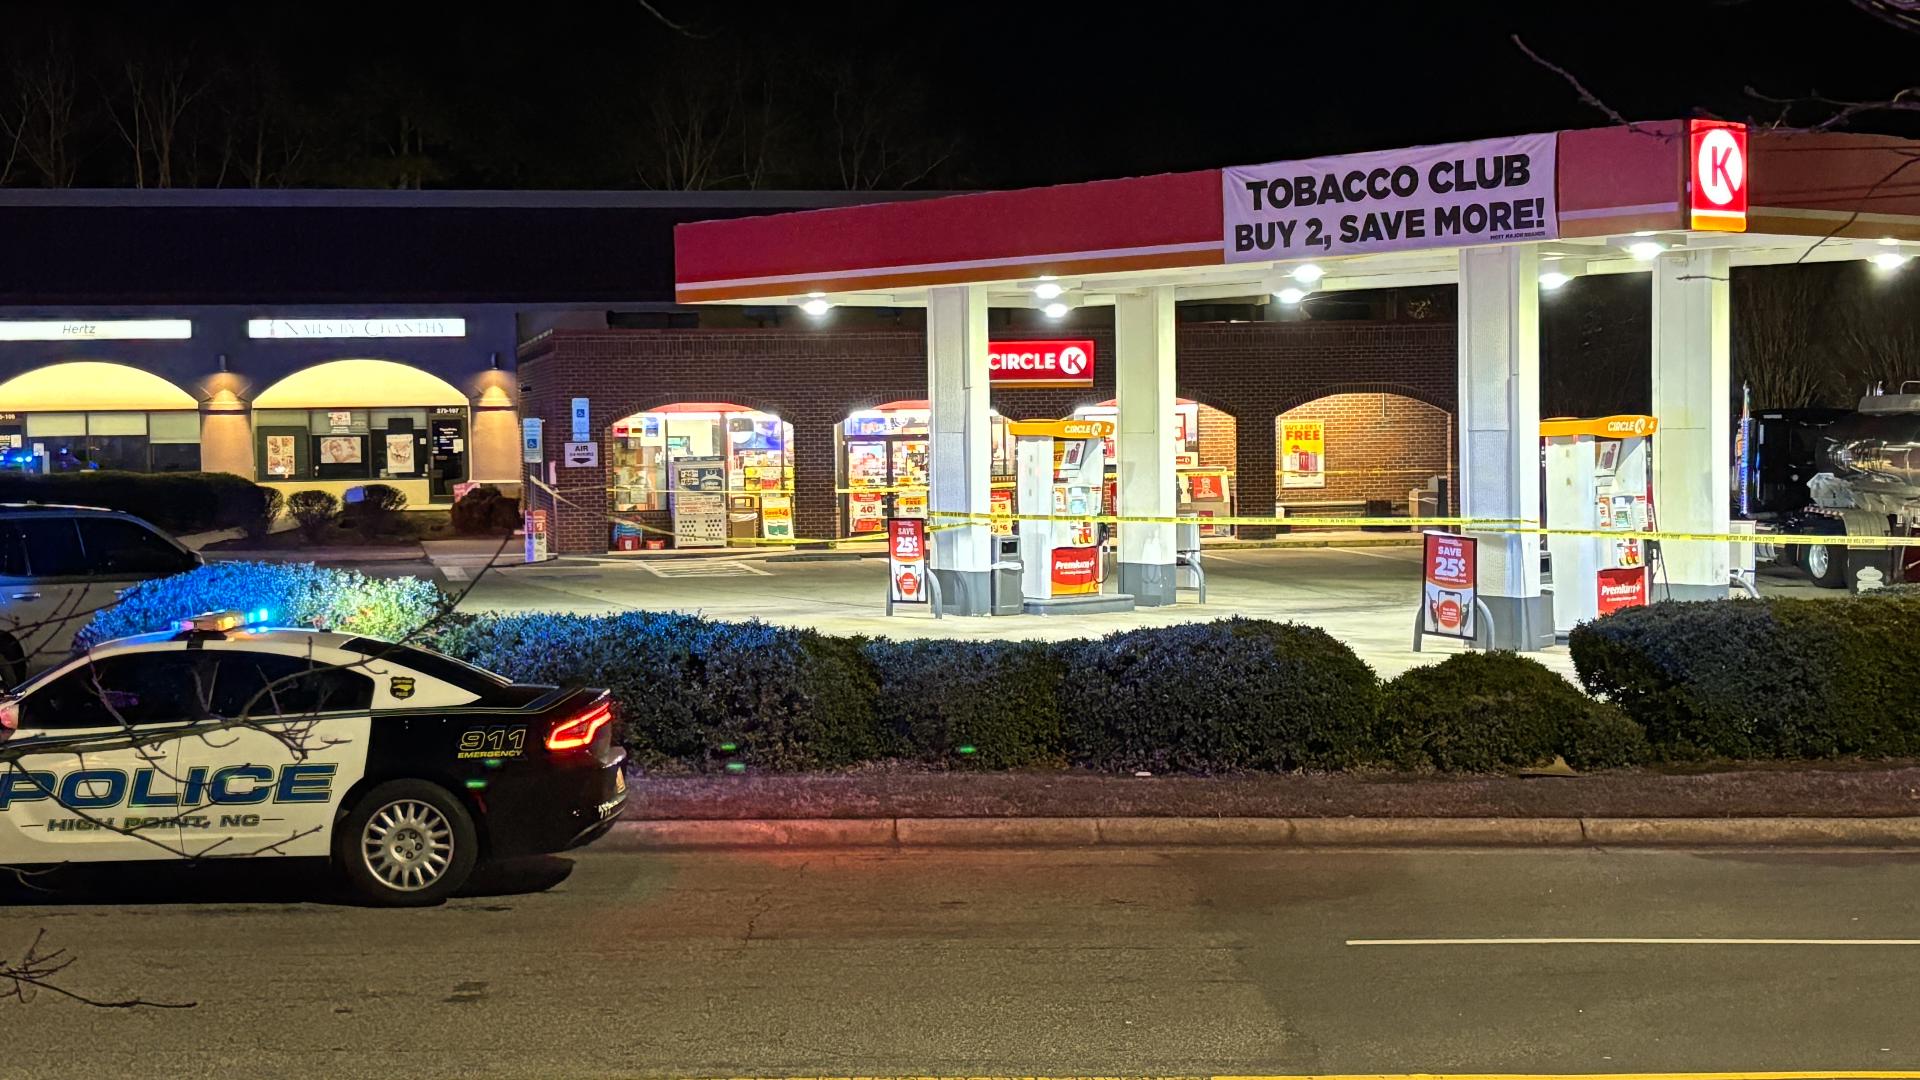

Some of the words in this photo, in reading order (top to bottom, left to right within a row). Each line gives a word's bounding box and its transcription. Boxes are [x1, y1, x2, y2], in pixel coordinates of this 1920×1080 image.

[1246, 165, 1418, 211] TOBACCO
[1428, 153, 1530, 191] CLUB
[1235, 220, 1297, 251] BUY
[1304, 217, 1332, 251] 2,
[1339, 209, 1425, 243] SAVE
[1434, 197, 1545, 237] MORE!
[62, 324, 96, 335] Hertz
[988, 352, 1056, 370] CIRCLE
[1286, 430, 1321, 441] FREE
[897, 527, 915, 535] SAVE
[896, 535, 918, 553] 25¢
[1438, 546, 1463, 557] SAVE
[1434, 556, 1466, 577] 25¢
[460, 729, 526, 751] 911
[457, 750, 523, 758] EMERGENCY
[0, 763, 338, 811] POLICE
[47, 818, 114, 832] HIGH
[219, 814, 260, 828] NC
